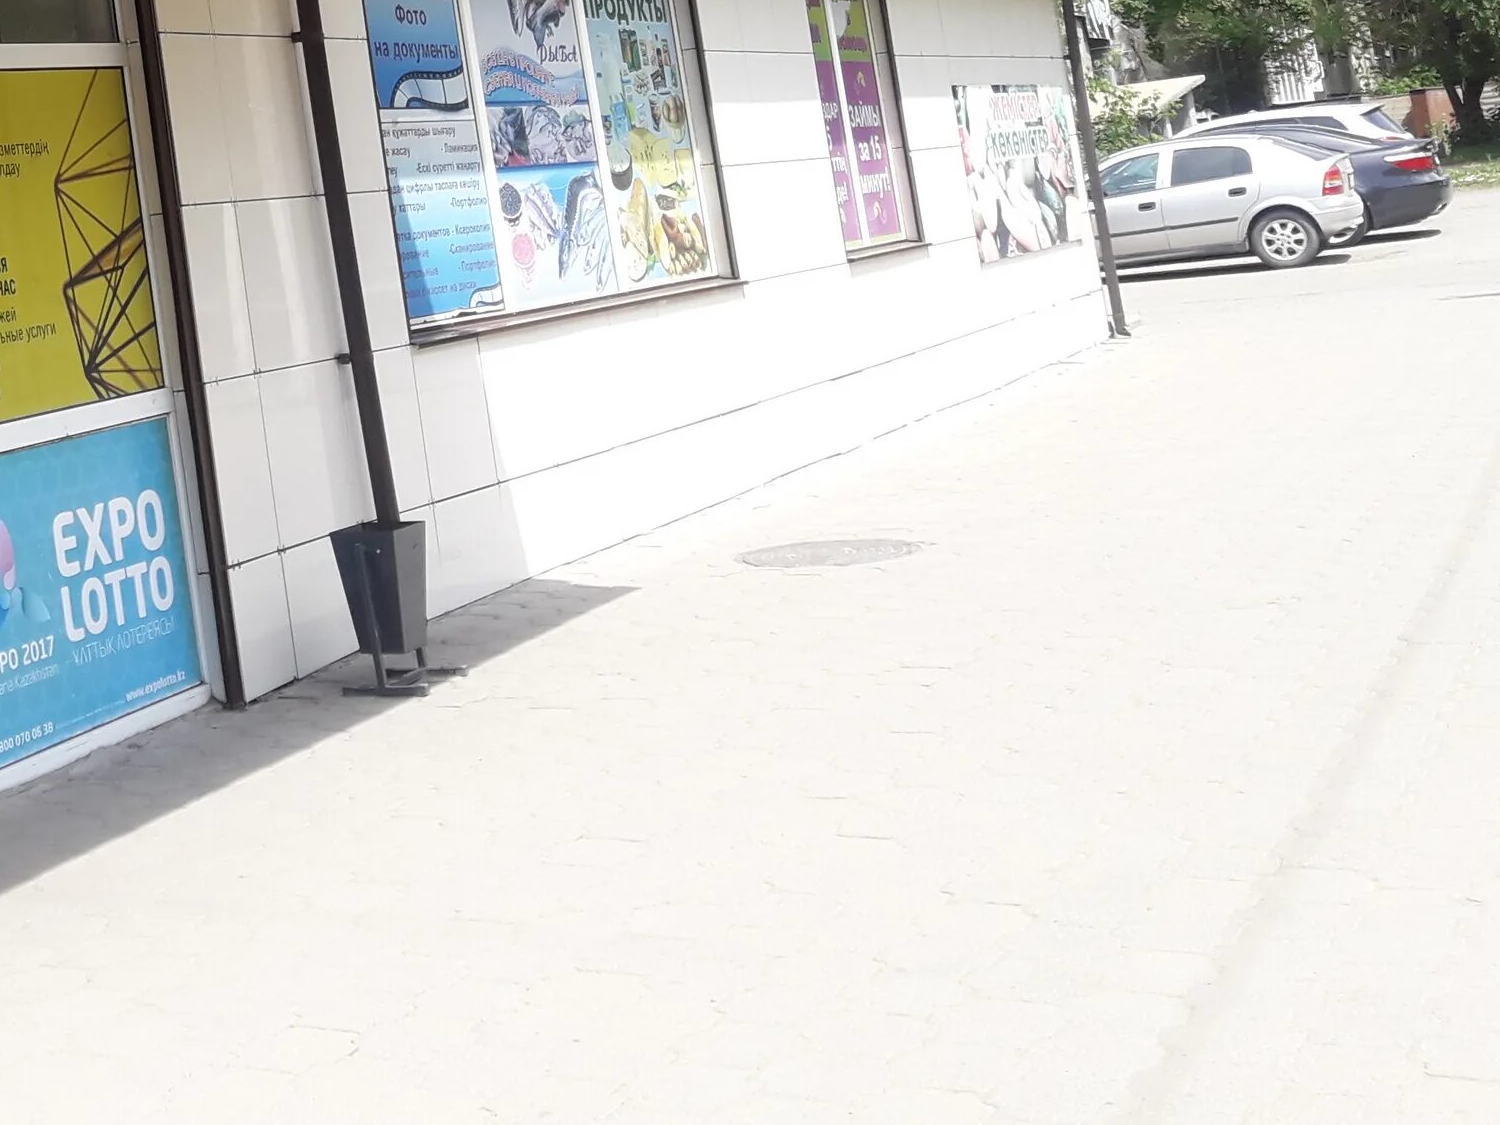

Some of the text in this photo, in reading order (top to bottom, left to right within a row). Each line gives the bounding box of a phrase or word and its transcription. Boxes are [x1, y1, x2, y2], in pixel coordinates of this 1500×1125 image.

[395, 4, 427, 25] Фото
[374, 41, 459, 63] на документы
[848, 101, 882, 129] ЗАЙМЫ
[870, 135, 883, 161] 15
[26, 323, 57, 344] услуги
[53, 489, 166, 577] EXPO
[61, 556, 175, 642] LOTTO
[115, 616, 175, 653] ЛОТЕРЕЯСЫ
[22, 635, 55, 664] 2017
[14, 663, 59, 688] Kazakhstan
[125, 670, 186, 703] www.expolotto.kz
[14, 732, 31, 748] 070
[32, 727, 43, 743] 06
[43, 722, 54, 737] 38
